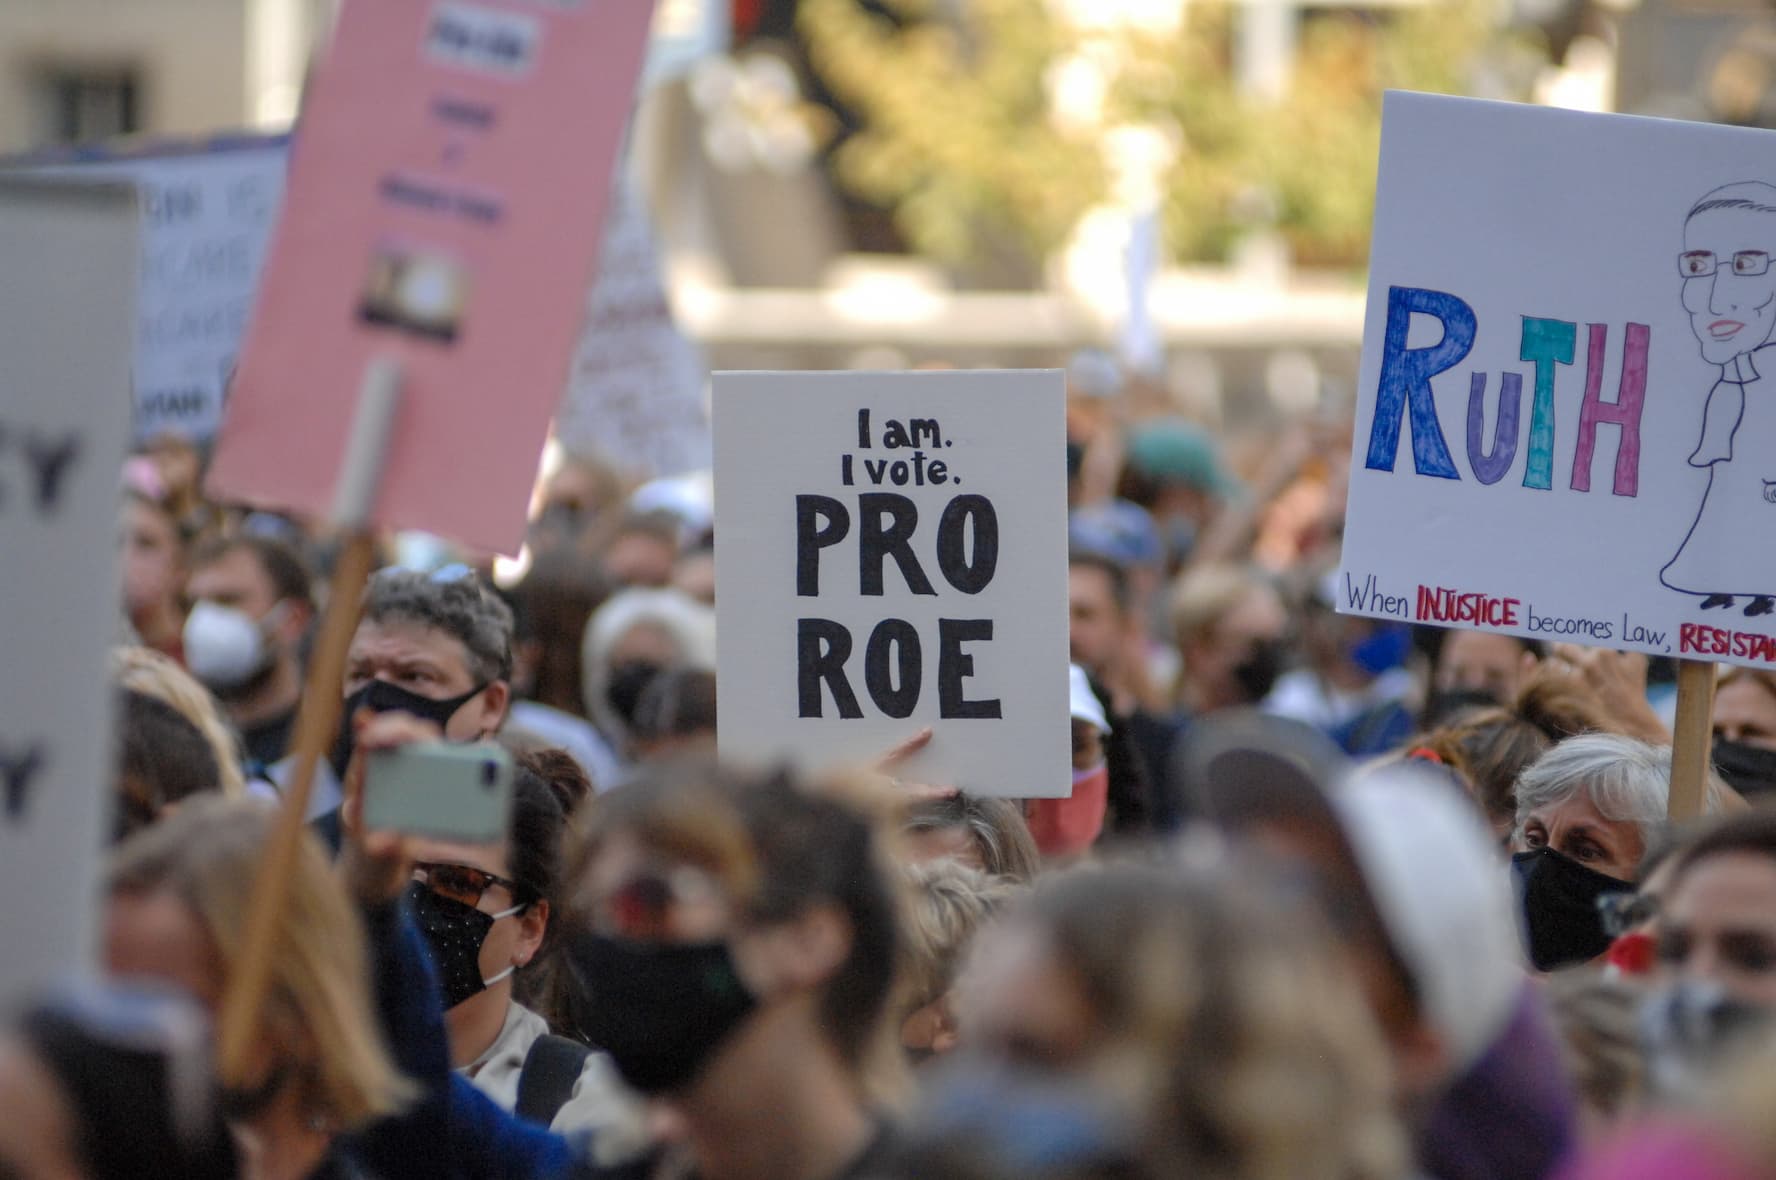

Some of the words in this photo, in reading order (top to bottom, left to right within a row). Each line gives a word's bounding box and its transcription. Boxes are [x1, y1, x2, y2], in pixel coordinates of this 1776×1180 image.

[858, 408, 871, 449] I
[883, 418, 953, 449] am.
[1365, 285, 1650, 498] RUTH
[842, 454, 854, 486] I
[864, 451, 961, 486] vote.
[796, 492, 999, 597] PRO
[1346, 572, 1408, 618] When
[1416, 584, 1520, 628] INJUSTICE
[1528, 605, 1612, 640] becomes
[1623, 612, 1671, 653] Law,
[797, 618, 1003, 720] ROE
